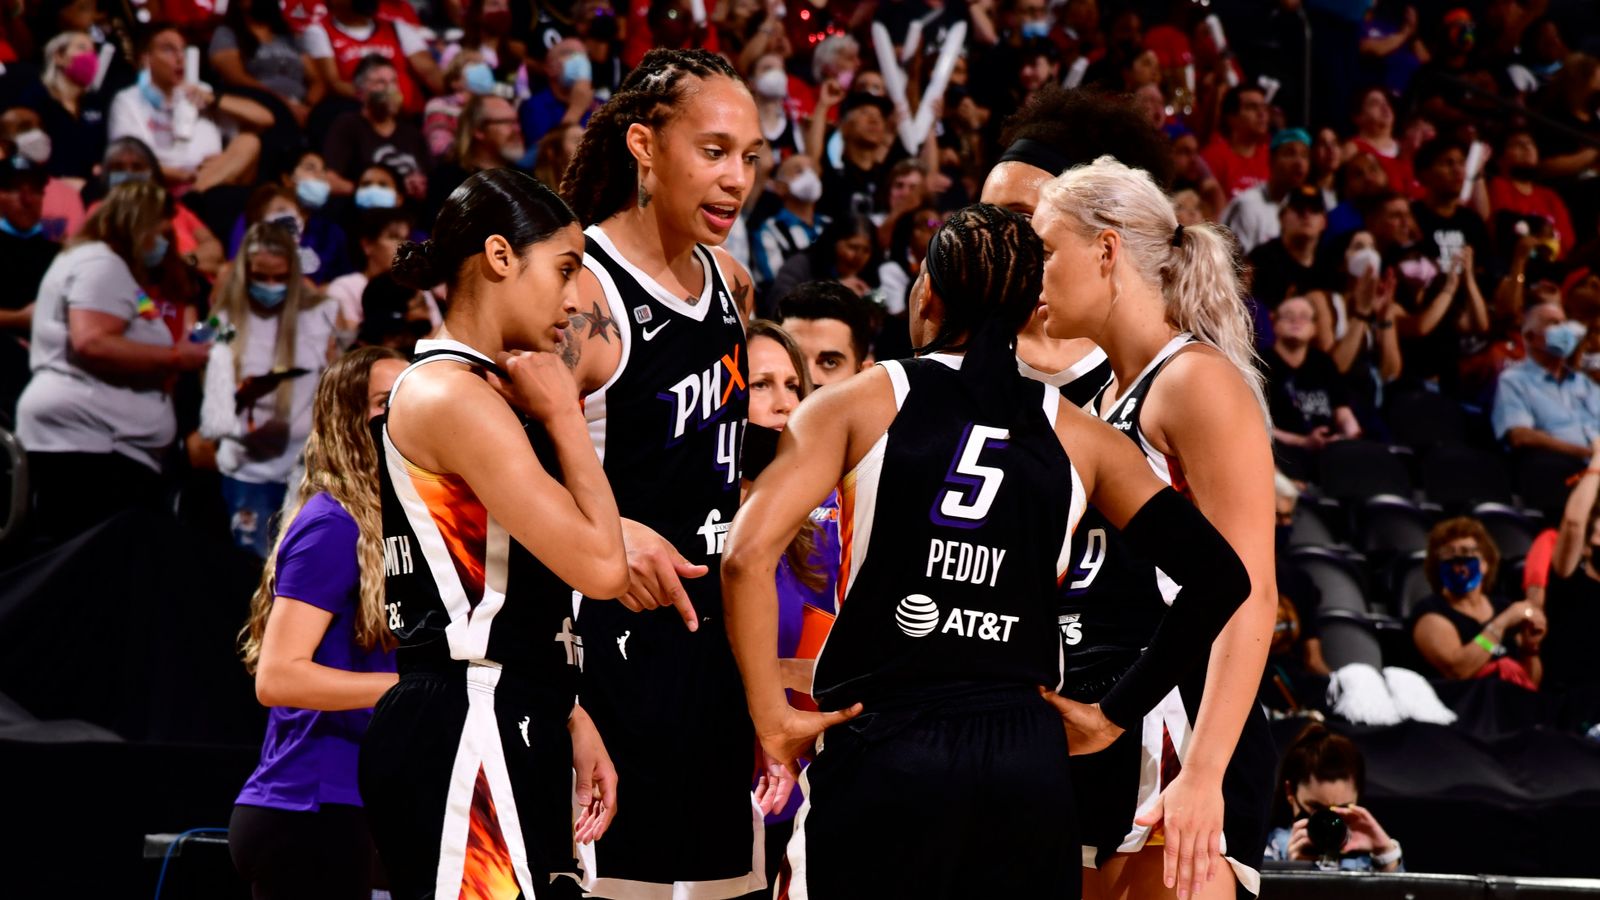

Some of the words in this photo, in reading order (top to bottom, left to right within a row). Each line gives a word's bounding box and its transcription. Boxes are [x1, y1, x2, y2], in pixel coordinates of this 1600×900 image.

[664, 343, 747, 441] PHX
[935, 423, 1011, 524] 5
[925, 538, 1007, 588] PEDDY
[1070, 527, 1107, 590] 9
[941, 607, 1020, 643] AT&T
